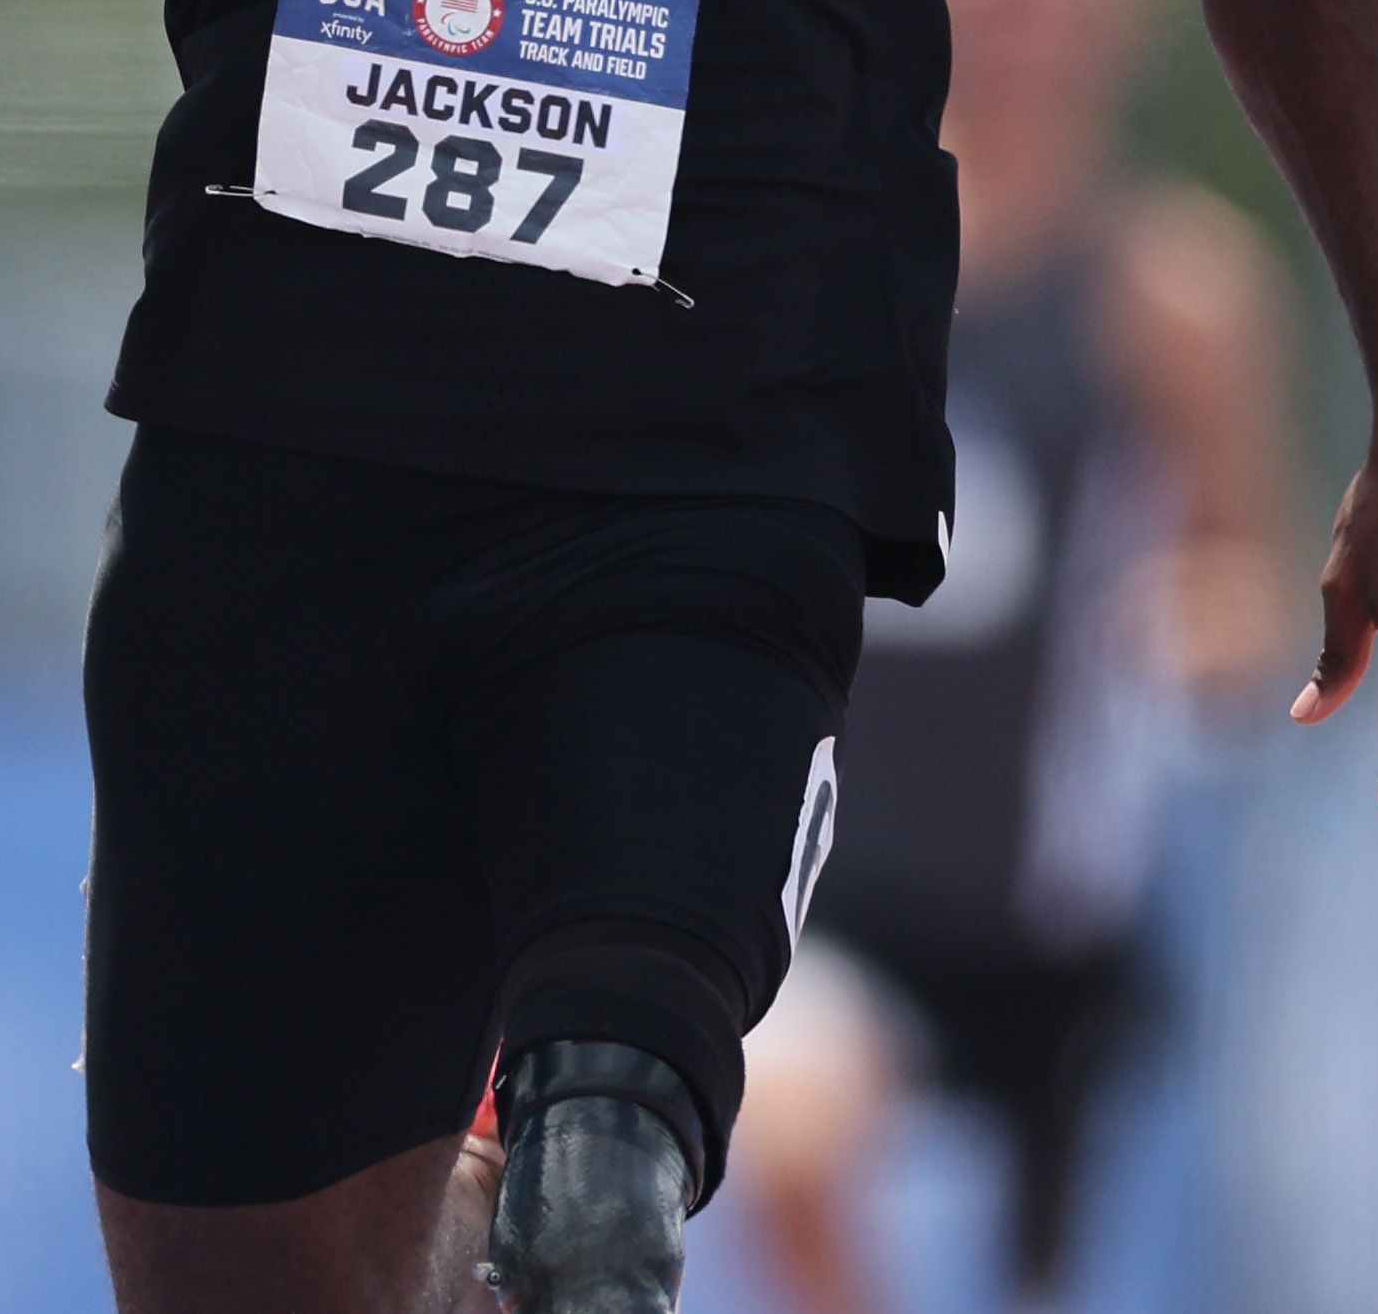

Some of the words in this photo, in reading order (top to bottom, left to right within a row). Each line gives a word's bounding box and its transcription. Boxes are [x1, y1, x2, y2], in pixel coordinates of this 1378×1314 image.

[320, 19, 373, 45] xfinity
[521, 8, 583, 45] TEAM
[589, 20, 666, 59] TRIALS
[519, 40, 569, 67] TRACK
[571, 49, 604, 72] AND
[606, 56, 647, 80] FIELD
[346, 63, 612, 149] JACKSON
[342, 118, 584, 245] 287
